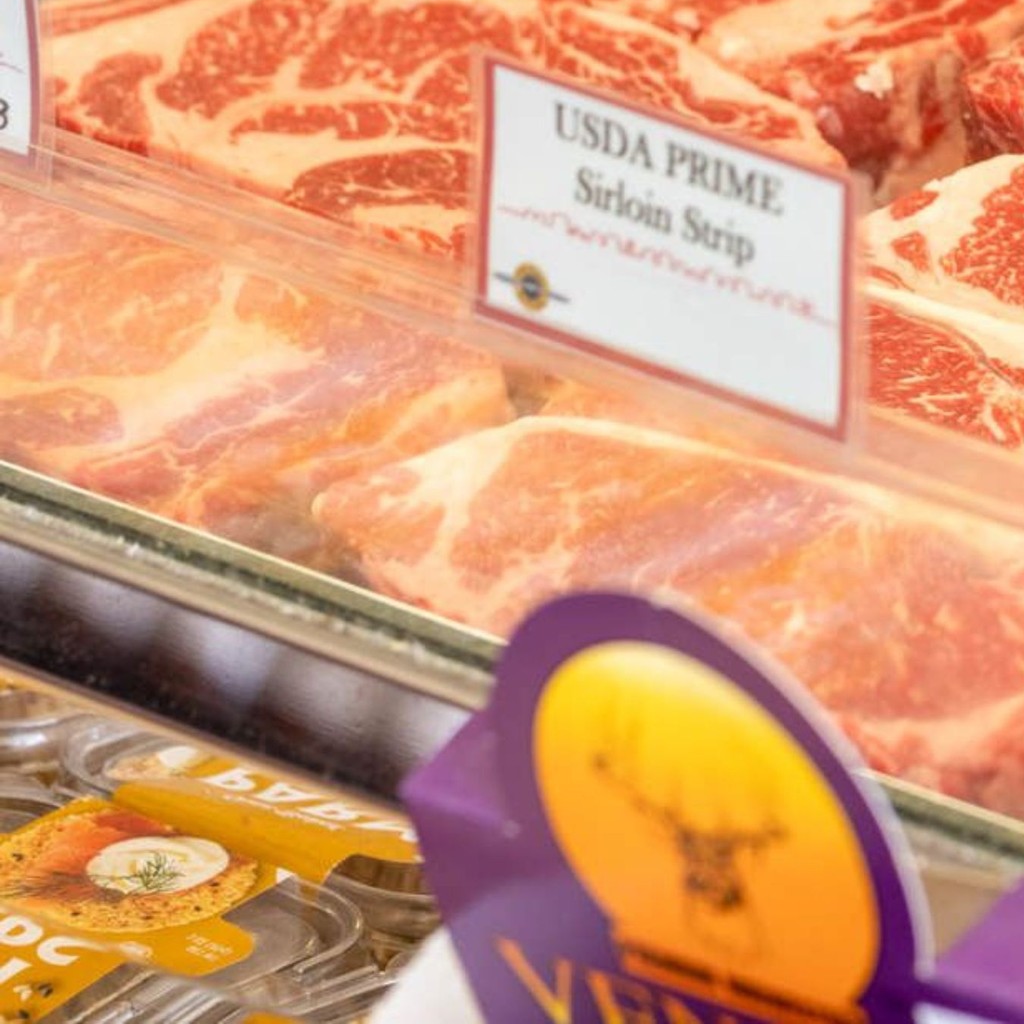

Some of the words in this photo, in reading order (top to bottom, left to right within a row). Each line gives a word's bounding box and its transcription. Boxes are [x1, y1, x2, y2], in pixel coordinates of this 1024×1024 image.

[554, 100, 654, 171] USDA
[664, 139, 785, 217] PRIME
[573, 166, 672, 235] Sirloin
[680, 205, 757, 269] Strip
